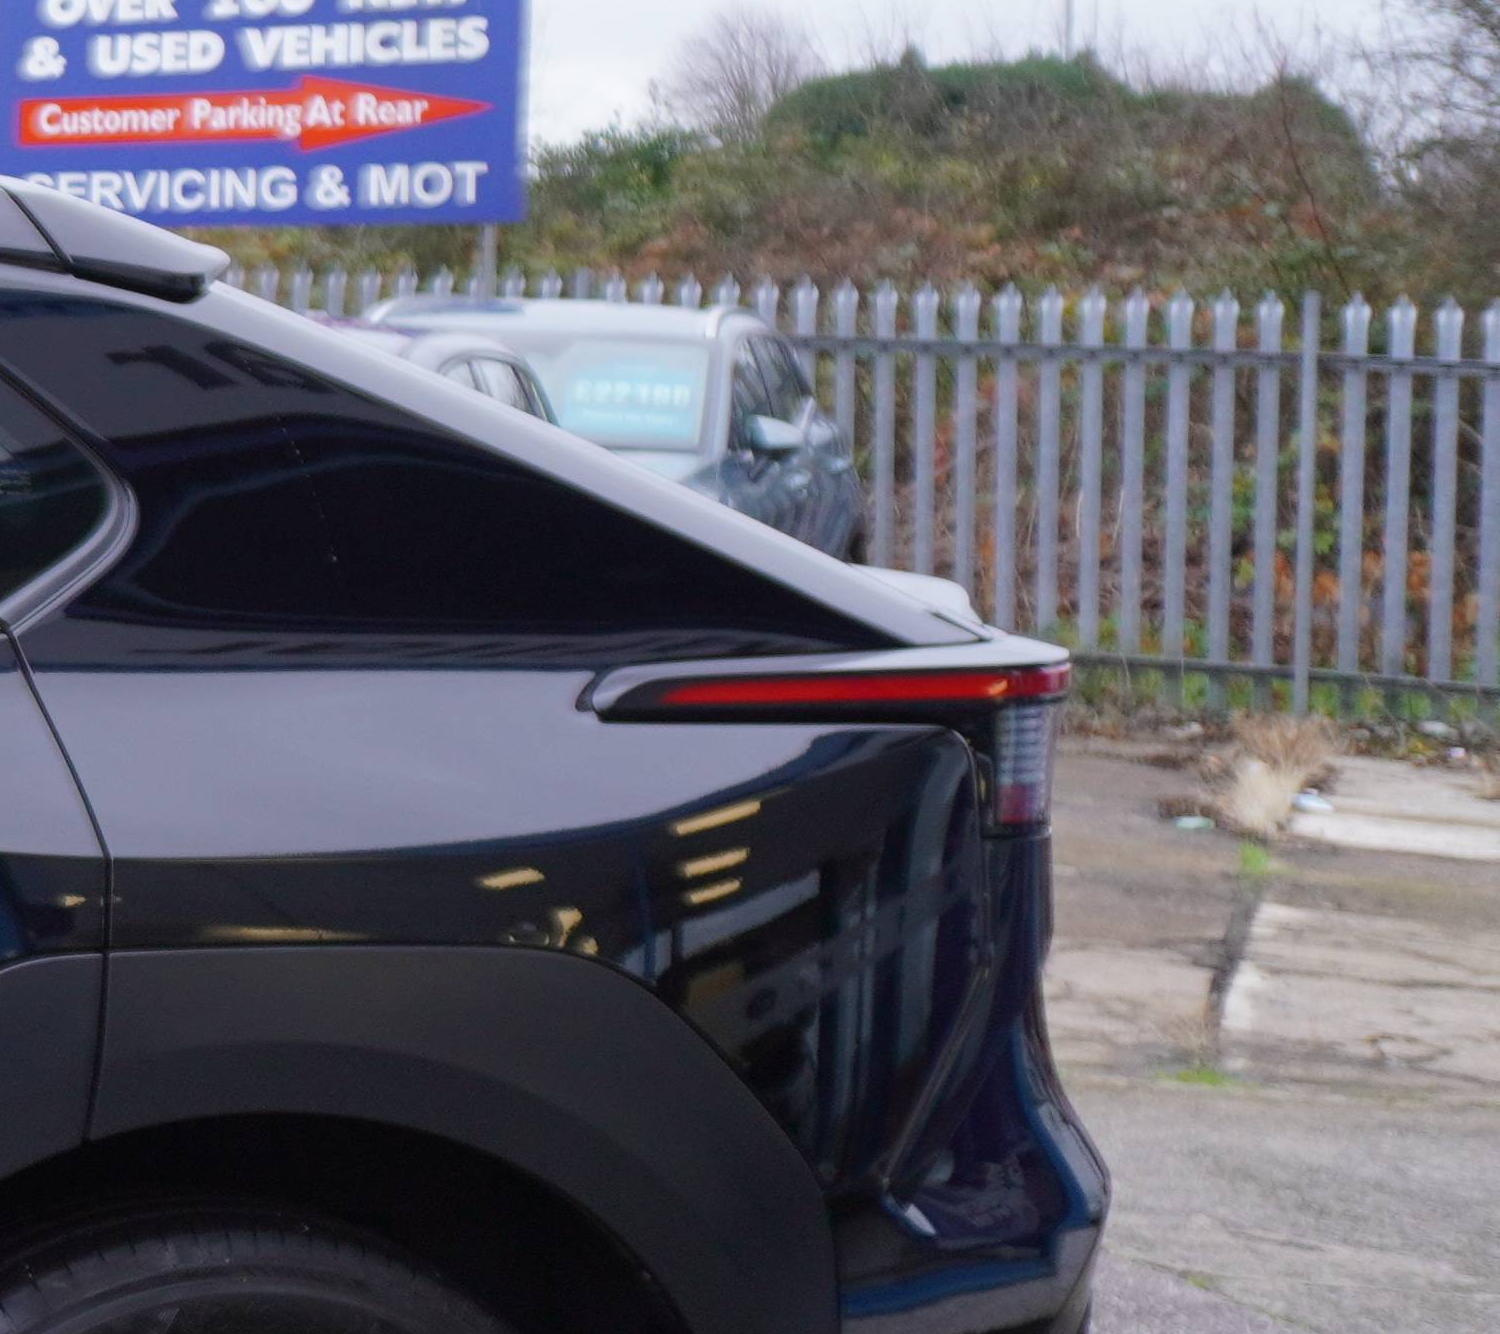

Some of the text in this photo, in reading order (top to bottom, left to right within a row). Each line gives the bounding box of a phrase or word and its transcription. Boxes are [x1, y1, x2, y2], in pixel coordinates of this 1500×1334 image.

[18, 15, 490, 81] & USED VEHICLES
[35, 92, 428, 141] Customer Parking At Rear
[312, 163, 351, 208] &
[368, 161, 489, 207] MOT
